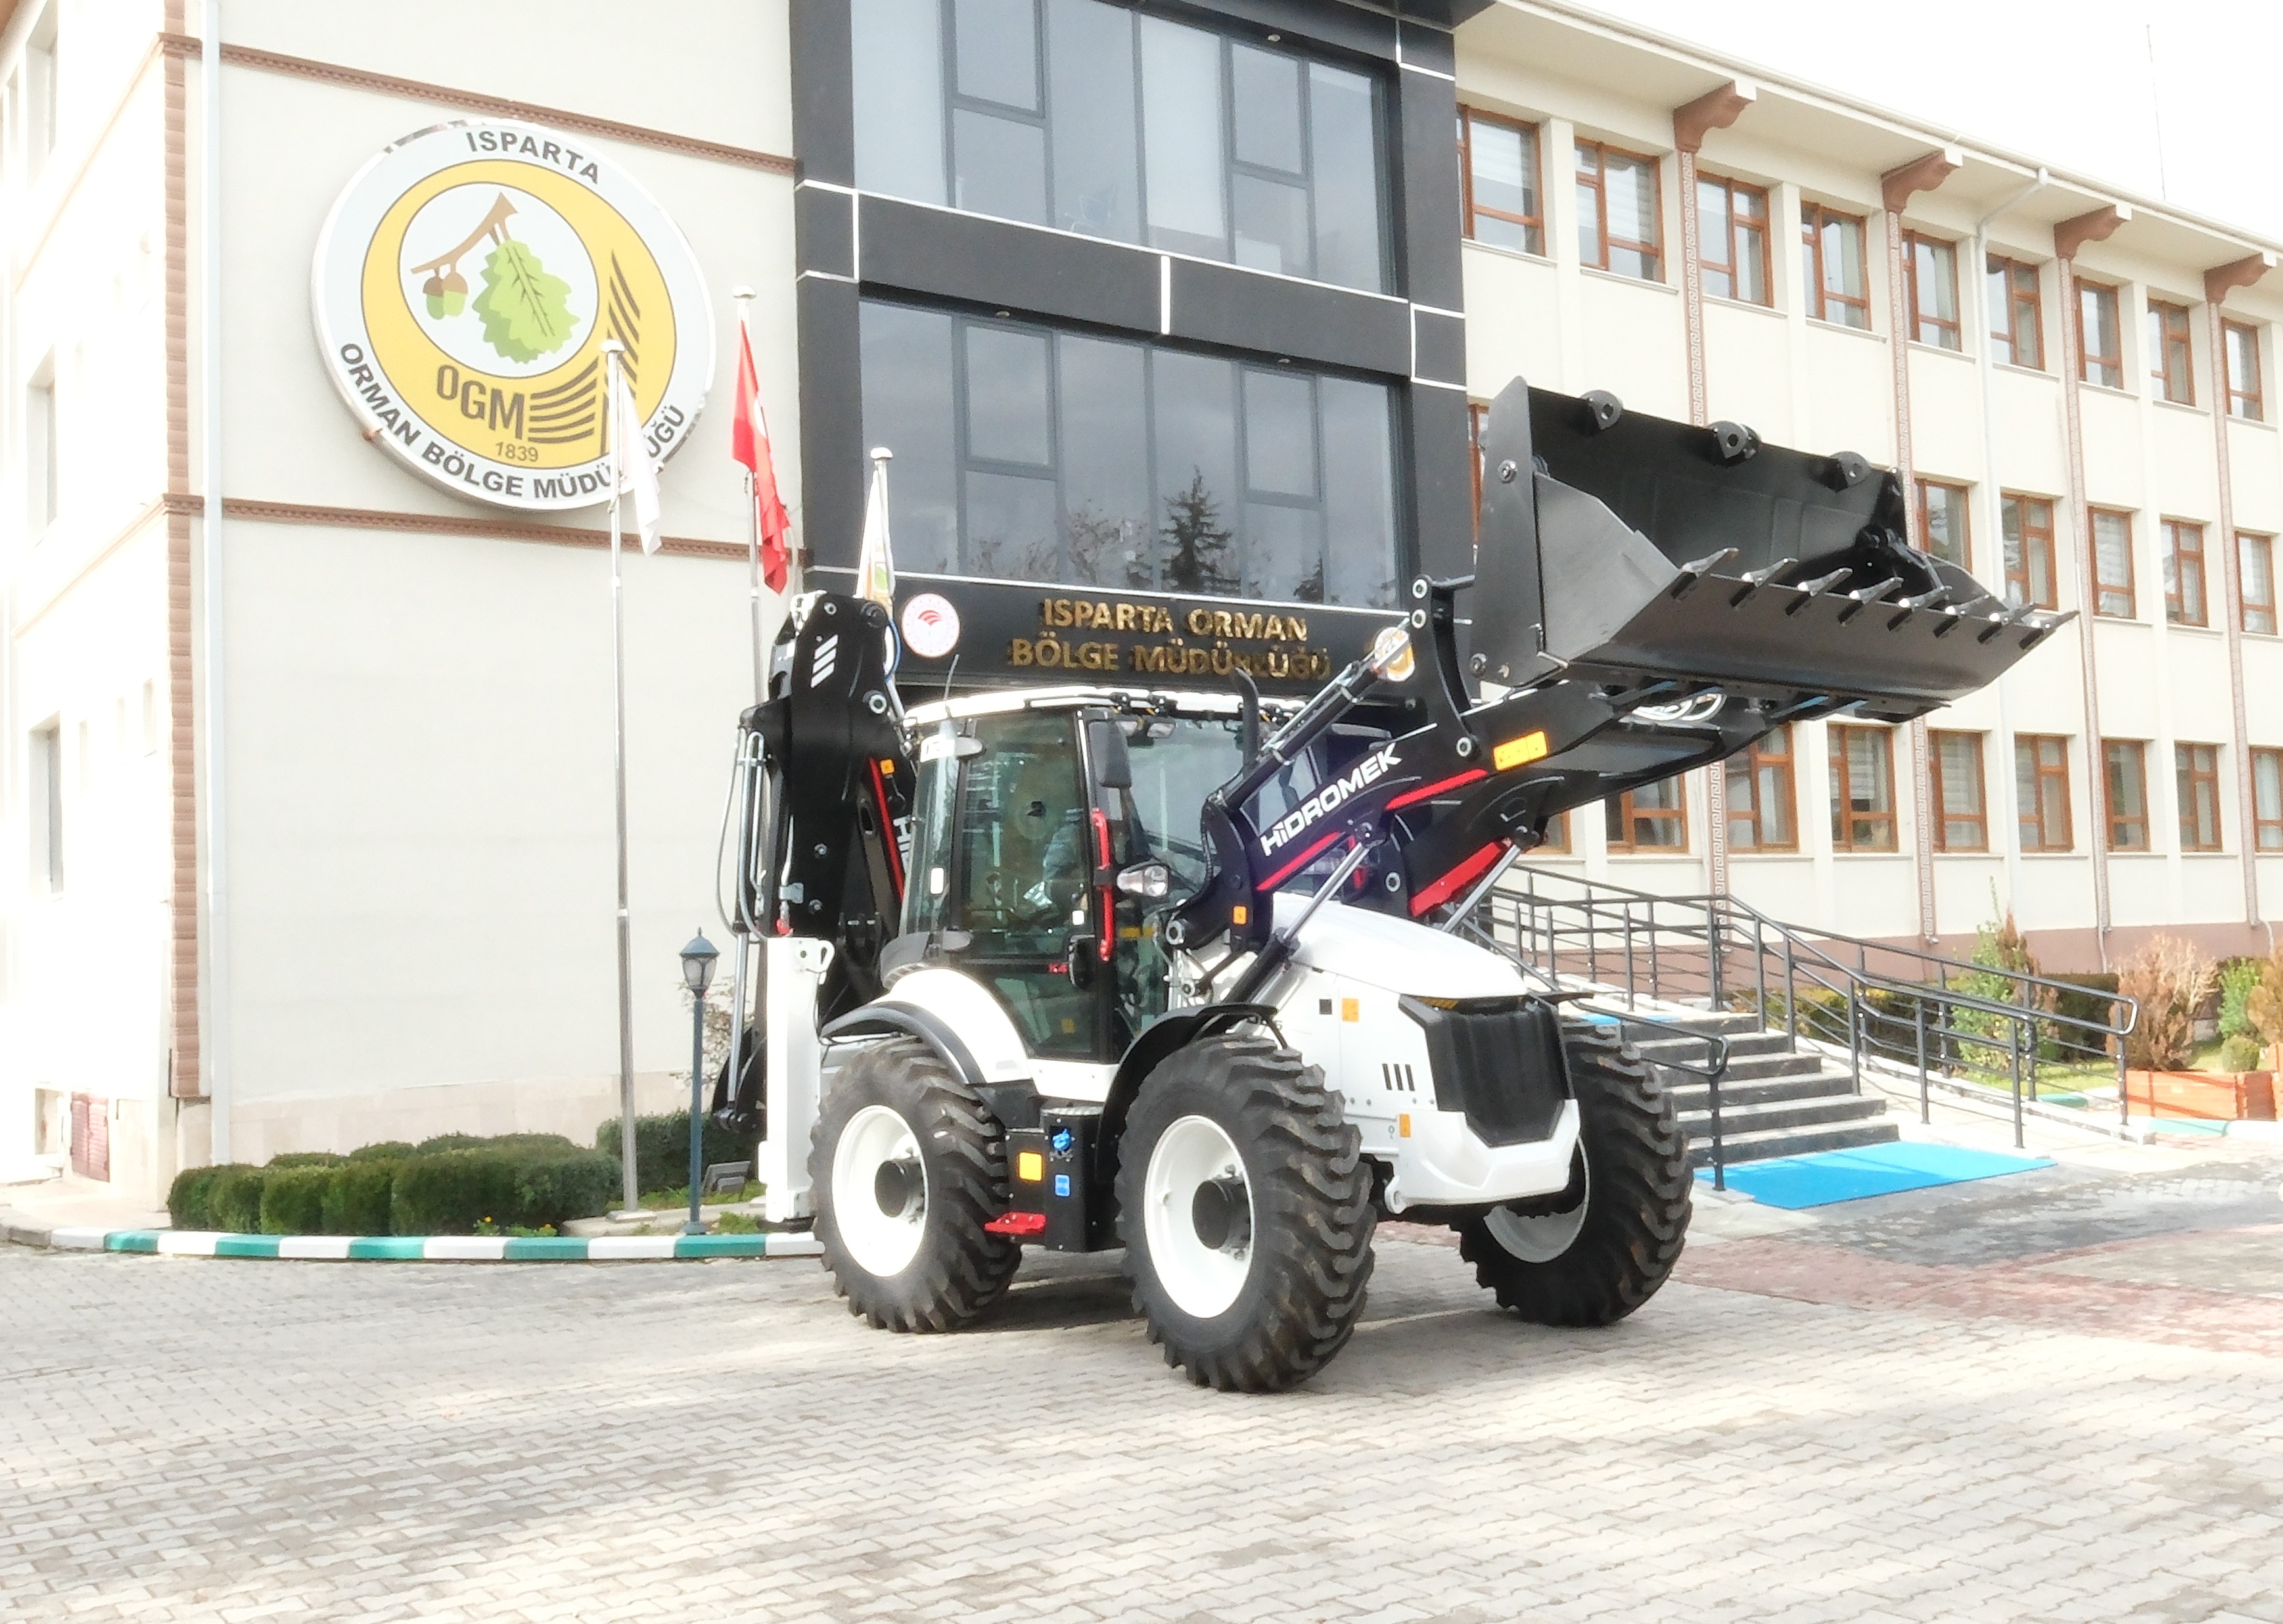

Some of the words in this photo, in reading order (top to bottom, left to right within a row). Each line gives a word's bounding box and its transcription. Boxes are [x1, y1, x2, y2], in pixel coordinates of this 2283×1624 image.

[466, 131, 598, 185] ISPARTA
[340, 343, 421, 446] ORMAN
[421, 440, 524, 497] BÖLGE
[534, 404, 685, 499] MÜDÜÜĞÜ
[436, 365, 525, 440] OGM
[496, 442, 539, 463] 1839
[1042, 597, 1174, 634] ISPARTA
[1188, 608, 1308, 642] ORMAN
[1011, 630, 1118, 671] BÖLGE
